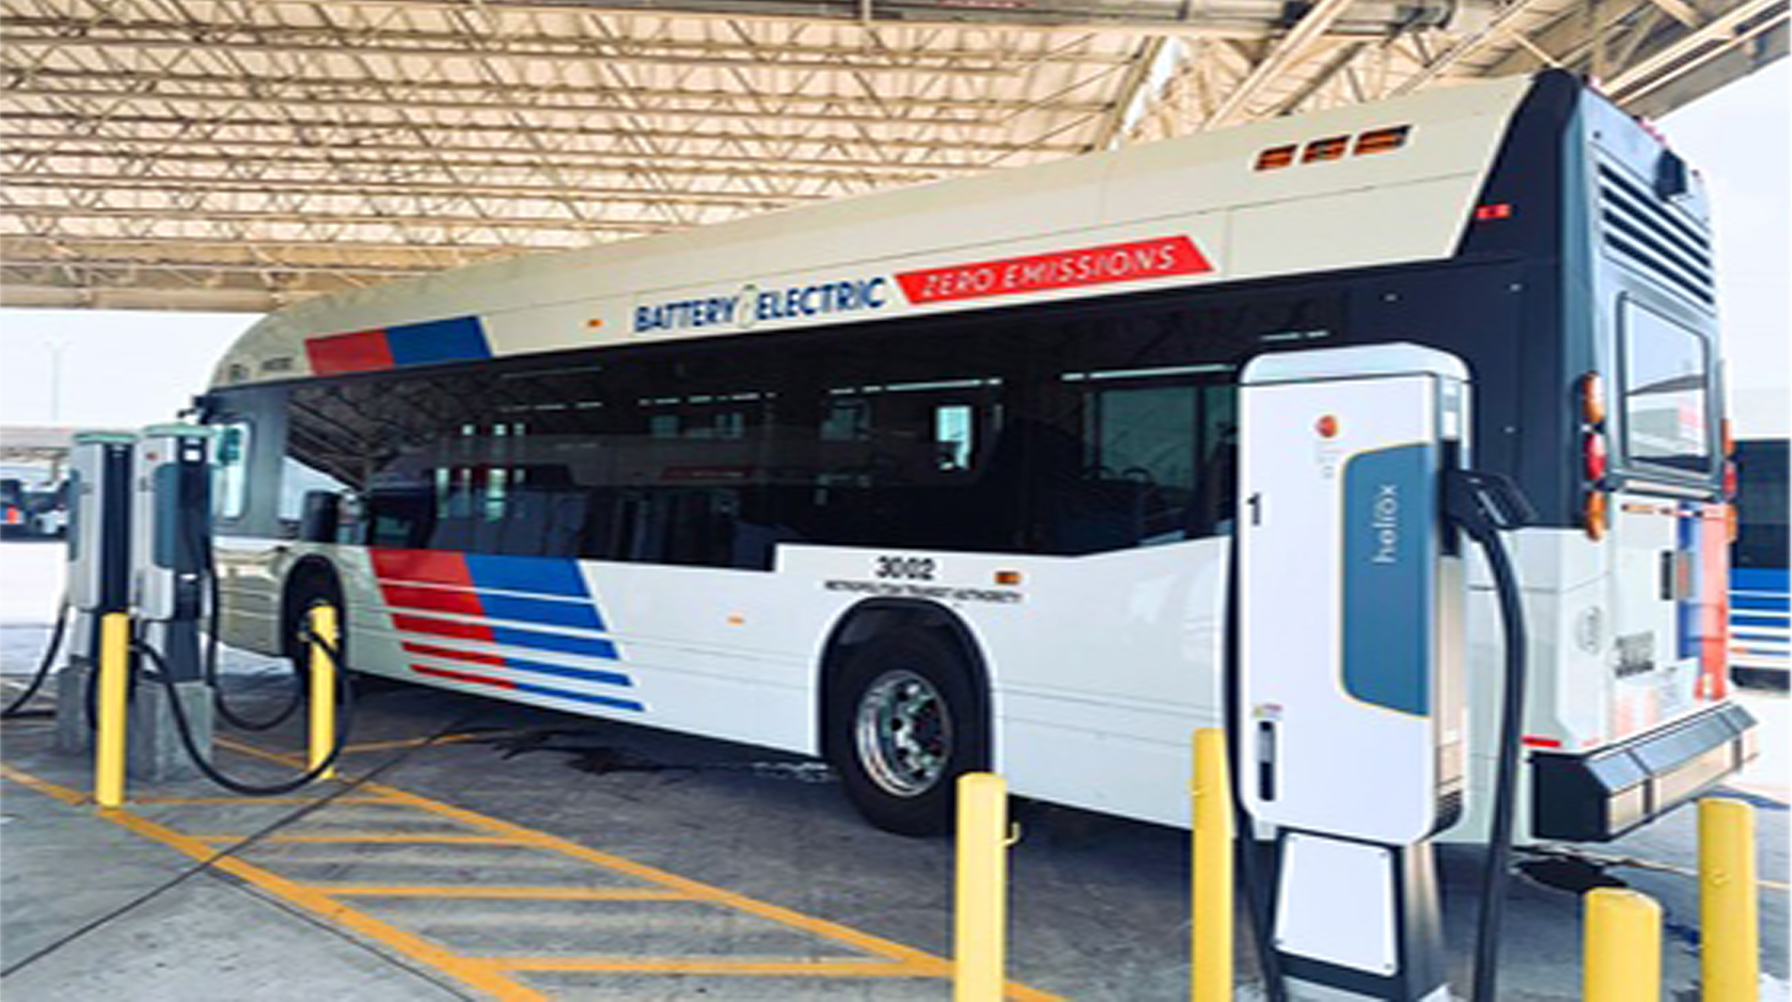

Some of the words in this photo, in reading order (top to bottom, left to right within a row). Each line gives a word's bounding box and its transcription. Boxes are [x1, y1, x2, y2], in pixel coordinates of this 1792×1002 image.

[921, 272, 994, 297] ZERO
[1003, 245, 1175, 289] EMISSIONS
[634, 296, 738, 332] BATTERY
[757, 277, 887, 321] ELECTRIC
[1246, 493, 1261, 526] 1
[875, 555, 936, 580] 3002
